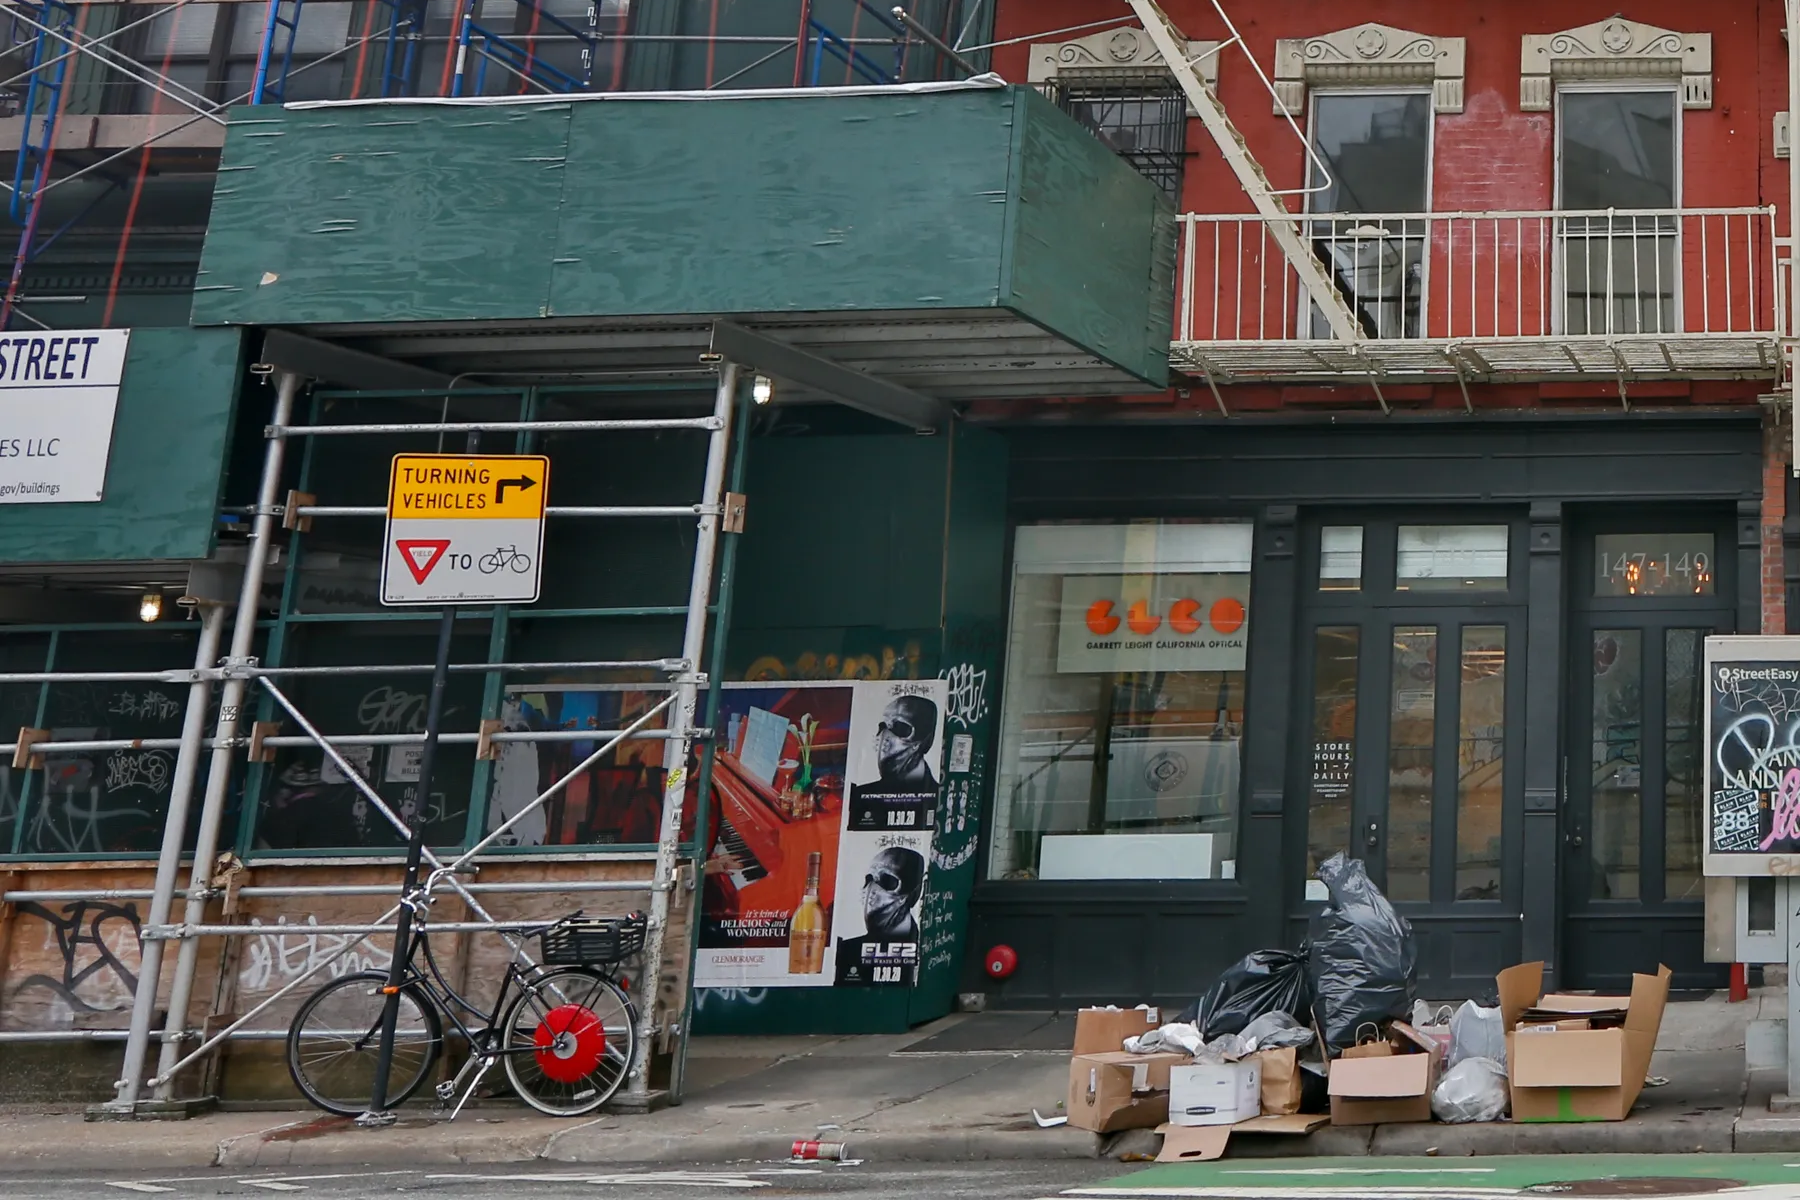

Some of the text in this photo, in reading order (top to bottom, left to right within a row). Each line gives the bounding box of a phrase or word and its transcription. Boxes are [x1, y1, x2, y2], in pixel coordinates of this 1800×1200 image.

[26, 438, 60, 457] LLC
[403, 468, 490, 484] TURNING
[403, 493, 487, 509] VEHICLES
[449, 554, 472, 570] TO
[1601, 552, 1709, 578] 147-149
[1086, 640, 1242, 649] GARRETT LEIGHT CALIFORNIA OPTICAL
[1733, 668, 1799, 683] StreetEasy
[887, 811, 915, 826] 10.30.20
[1722, 811, 1750, 831] 88
[759, 909, 779, 918] kind
[780, 909, 790, 919] of
[720, 918, 787, 929] DELICIOUS and
[727, 928, 787, 938] WONDERFUL
[712, 955, 765, 964] GLENMORANGIE
[873, 967, 901, 982] 10.30.20
